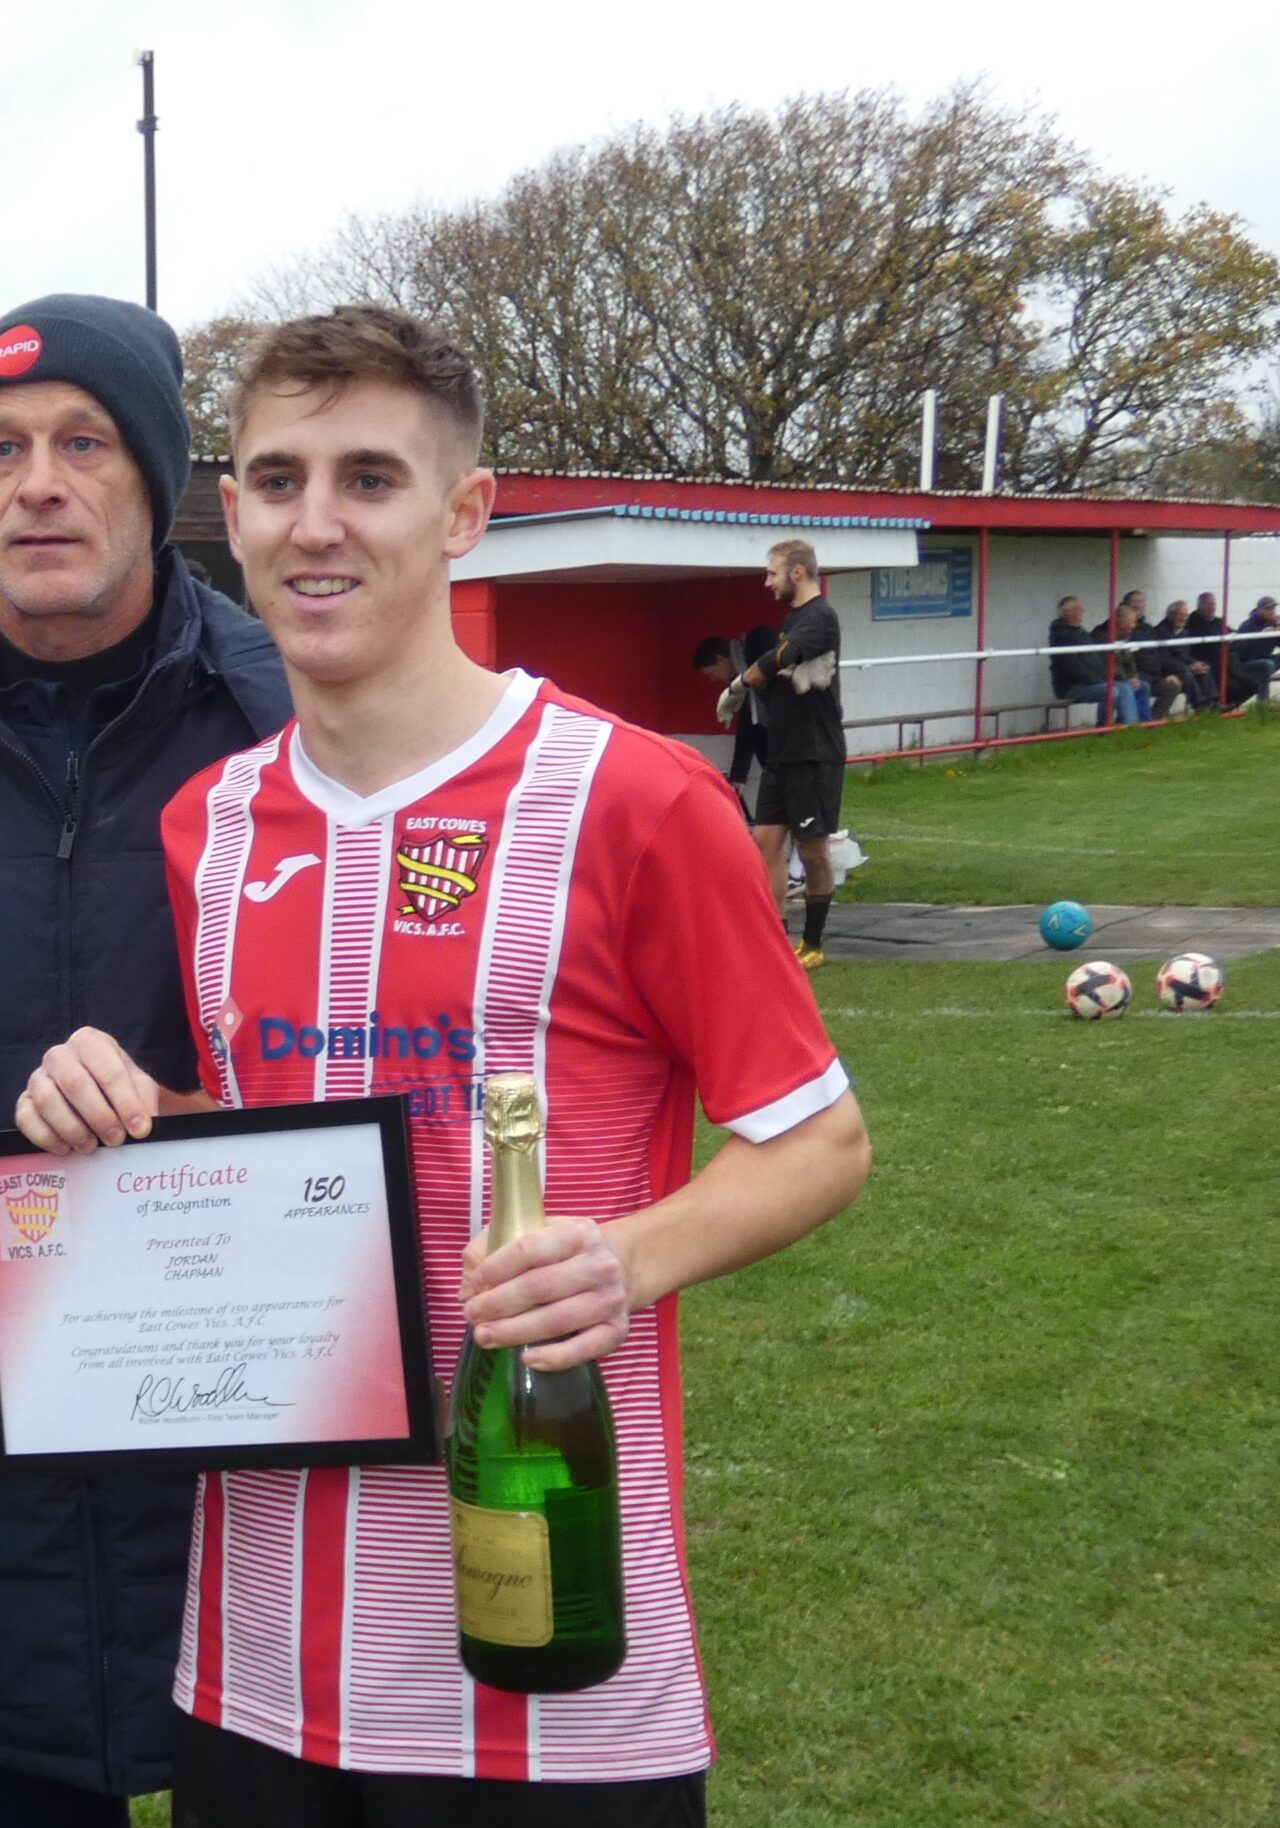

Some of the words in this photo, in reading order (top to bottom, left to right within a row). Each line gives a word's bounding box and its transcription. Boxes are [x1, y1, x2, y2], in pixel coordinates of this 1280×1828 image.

[406, 817, 439, 830] EAST
[437, 818, 487, 833] COWES
[393, 920, 425, 935] VICS.
[258, 1011, 477, 1062] Domino's
[26, 1173, 67, 1190] COWES
[116, 1163, 250, 1197] Certificate
[303, 1174, 347, 1202] 150
[136, 1200, 151, 1217] of
[152, 1197, 232, 1215] Recognition
[283, 1202, 372, 1220] APPEARANCES
[145, 1234, 214, 1251] Presented
[213, 1233, 232, 1246] To
[38, 1244, 67, 1259] A.F.C.
[164, 1253, 219, 1269] JORDAN
[163, 1267, 224, 1282] CHAPMAN
[59, 1312, 81, 1327] For
[82, 1309, 137, 1324] achieving
[139, 1306, 158, 1319] the
[160, 1304, 212, 1318] milestone
[216, 1301, 231, 1317] of
[251, 1299, 323, 1315] appearances
[321, 1295, 346, 1312] for
[138, 1321, 163, 1334] East
[165, 1320, 200, 1332] Cowes
[71, 1342, 159, 1359] Congratulations
[161, 1340, 185, 1352] and
[187, 1337, 219, 1350] thank
[223, 1338, 245, 1350] you
[245, 1335, 267, 1351] for
[267, 1335, 296, 1350] your
[297, 1330, 341, 1347] loyalty
[74, 1358, 105, 1374] from
[108, 1356, 125, 1369] all
[125, 1355, 175, 1368] involved
[176, 1353, 202, 1365] with
[205, 1351, 231, 1364] East
[233, 1350, 268, 1363] Cowes
